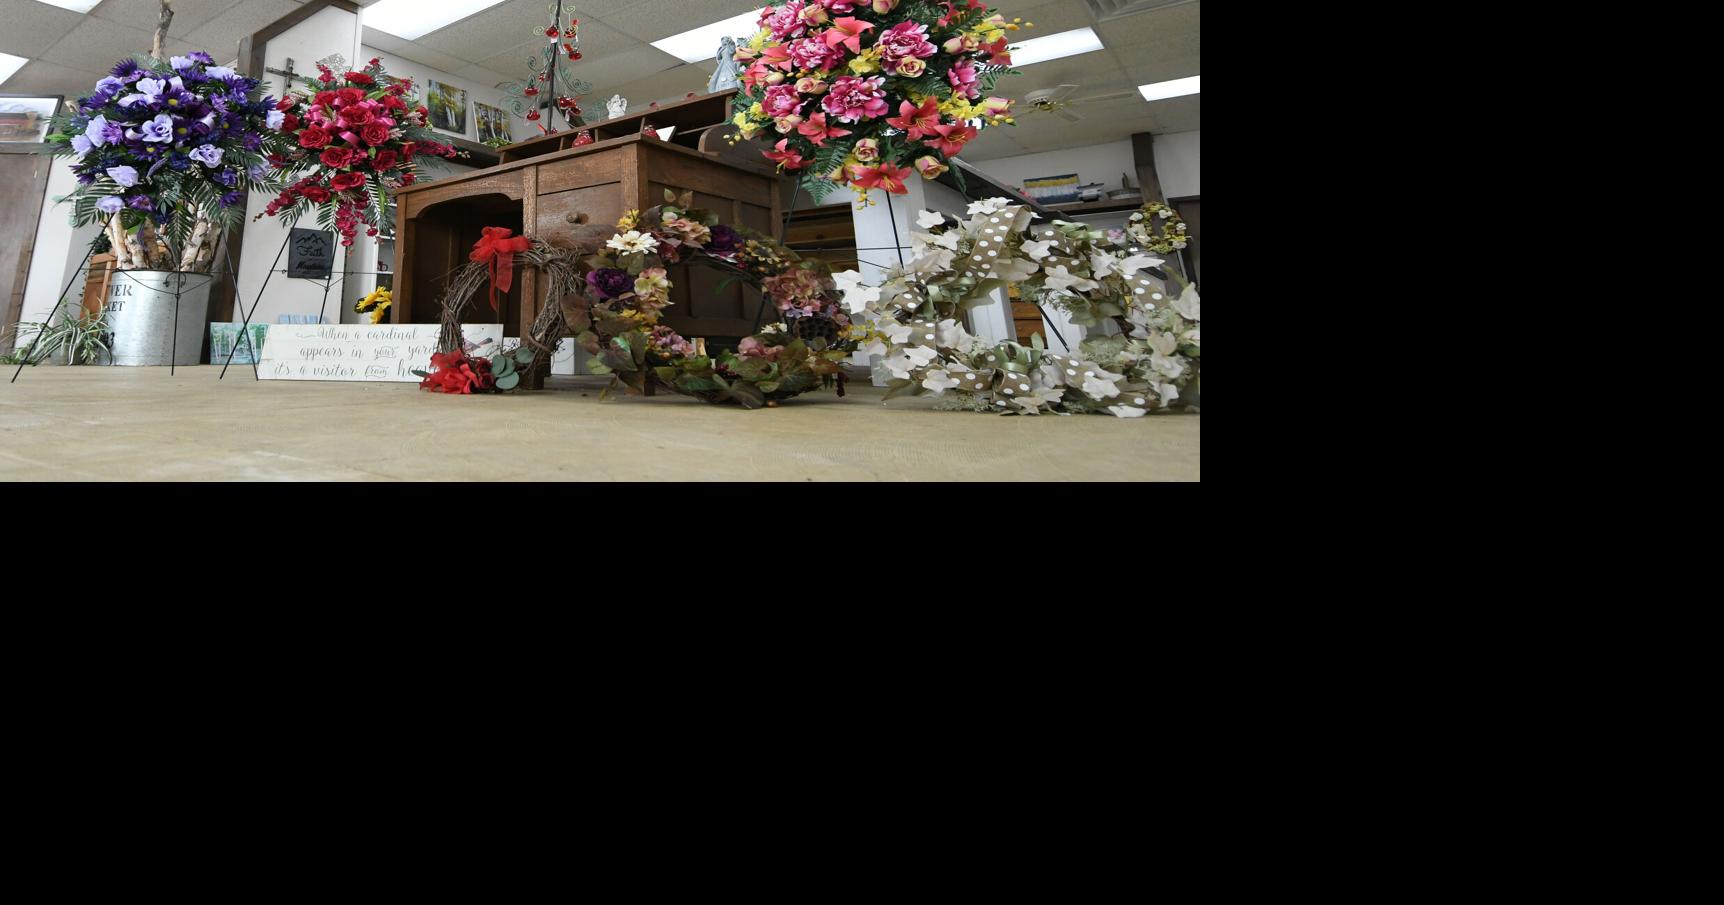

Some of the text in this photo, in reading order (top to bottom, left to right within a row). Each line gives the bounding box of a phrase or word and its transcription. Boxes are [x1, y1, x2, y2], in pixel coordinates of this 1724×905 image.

[319, 327, 417, 341] When a cardinal
[299, 346, 344, 359] appears
[351, 345, 364, 358] in
[374, 346, 397, 359] your
[274, 362, 291, 375] it's
[299, 367, 306, 376] a
[313, 363, 356, 377] visitor
